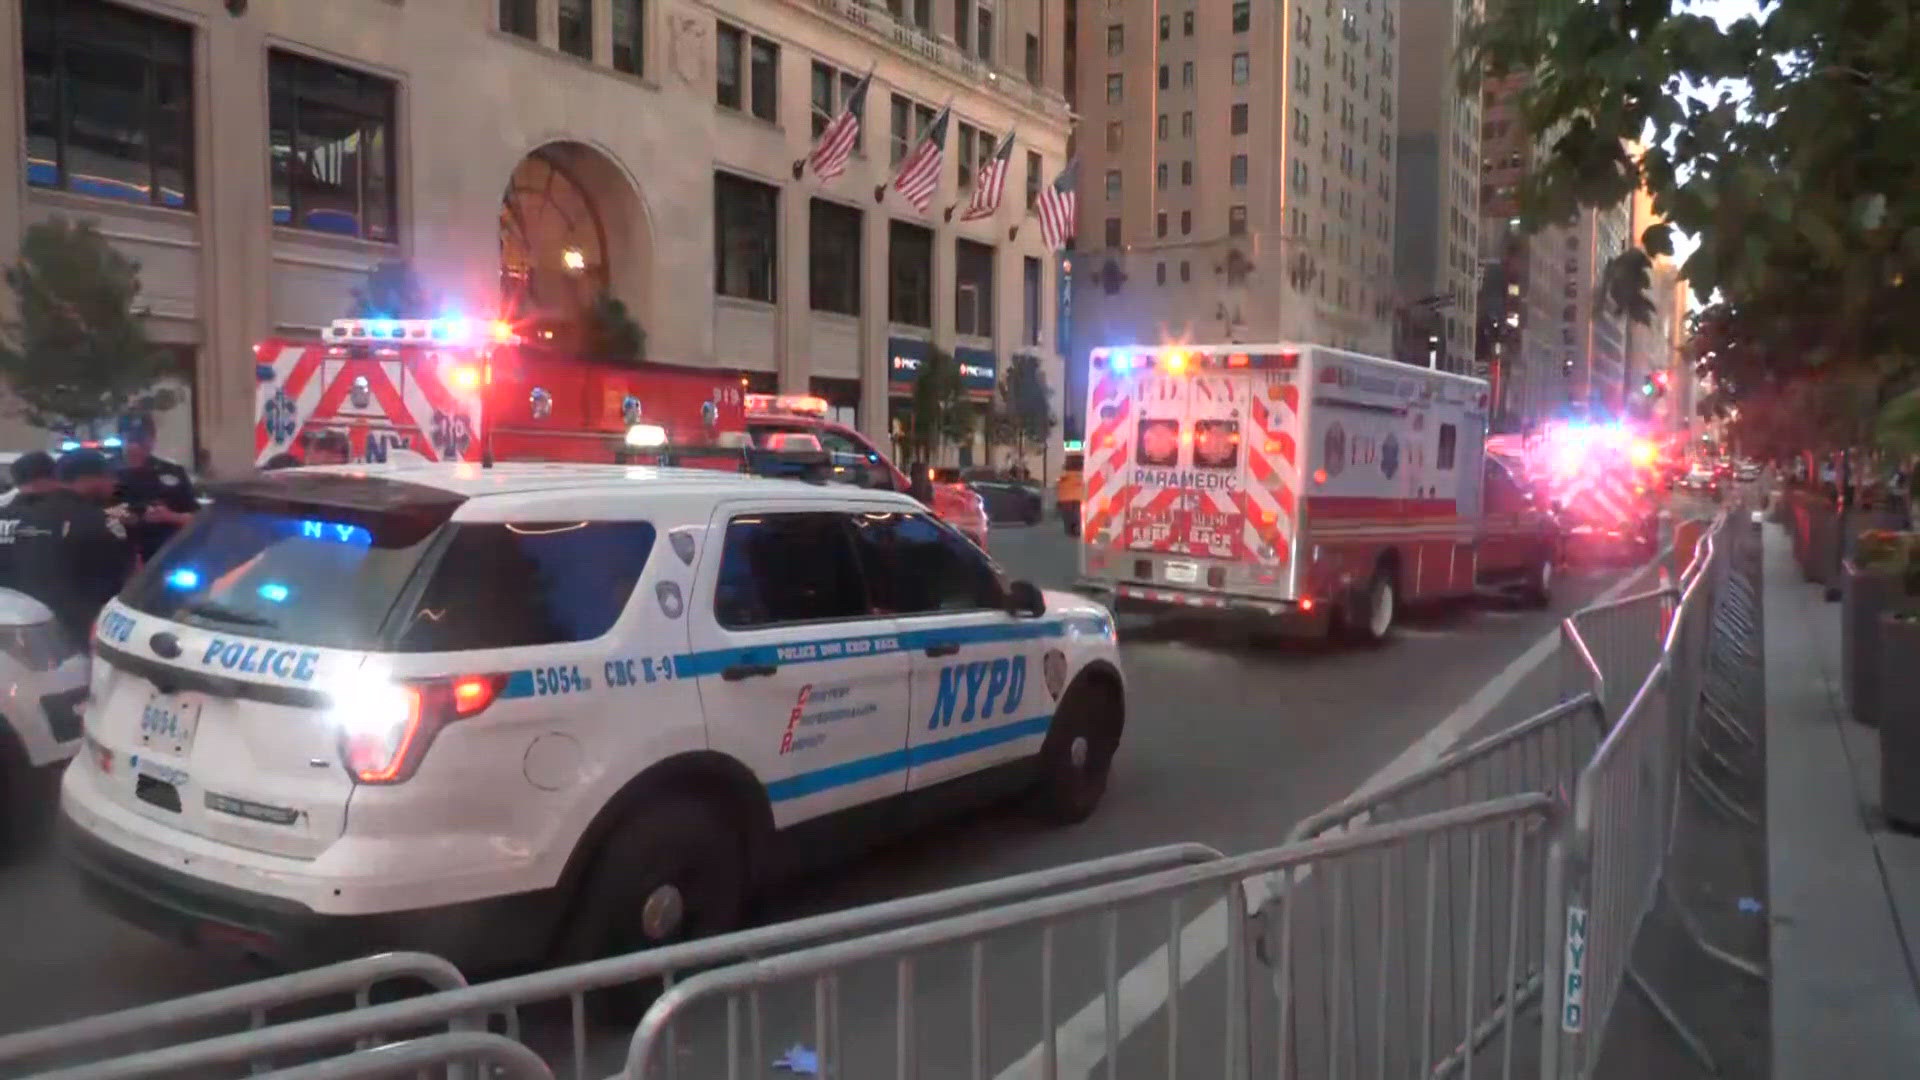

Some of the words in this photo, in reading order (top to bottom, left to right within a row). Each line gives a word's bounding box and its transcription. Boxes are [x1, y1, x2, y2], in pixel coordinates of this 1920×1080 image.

[1134, 470, 1238, 492] PARAMEDIC
[202, 636, 320, 682] POLICE
[536, 665, 582, 696] 5054
[929, 654, 1026, 730] NYPD
[1566, 913, 1586, 1027] NYPD
